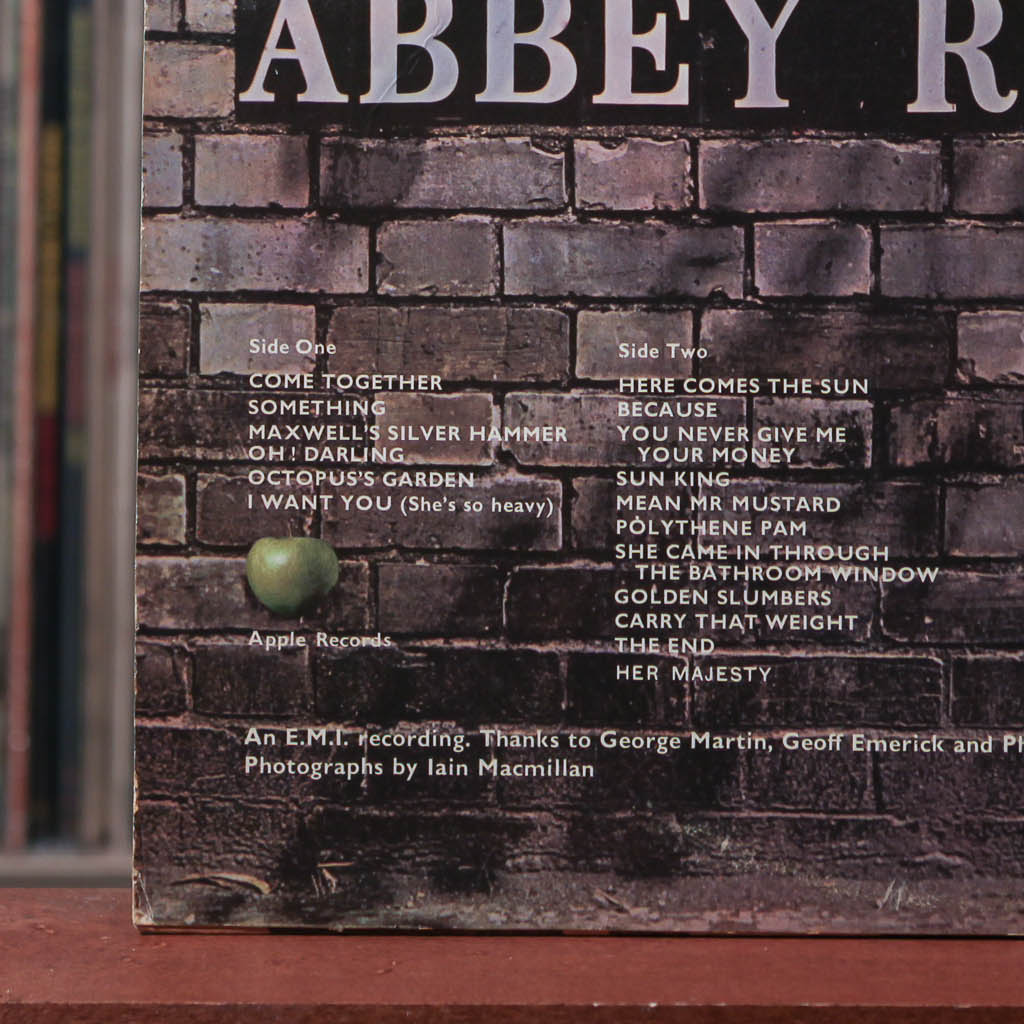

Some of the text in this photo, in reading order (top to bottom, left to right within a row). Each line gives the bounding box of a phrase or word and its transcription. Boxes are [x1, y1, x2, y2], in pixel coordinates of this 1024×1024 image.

[249, 339, 337, 355] Side One
[618, 343, 708, 359] Side Two
[249, 374, 442, 390] COME TOGETHER
[619, 378, 868, 394] HERE COMES THE SUN
[248, 399, 386, 416] SOMETHING
[618, 402, 718, 418] BECAUSE
[388, 426, 461, 442] SILVER
[470, 427, 568, 442] HAMMER
[616, 426, 847, 443] YOU NEVER GIVE ME
[305, 446, 404, 463] DARLING
[638, 446, 796, 463] YOUR MONEY
[382, 472, 475, 488] GARDEN
[616, 471, 730, 487] SUN KING
[248, 494, 253, 509] I
[261, 494, 333, 510] WANT
[340, 495, 392, 511] YOU
[463, 499, 482, 513] so
[491, 497, 554, 518] heavy)
[616, 495, 841, 513] MEAN MR MUSTARD
[616, 519, 807, 536] POLYTHENE PAM
[615, 544, 889, 562] SHE CAME IN THROUGH
[635, 565, 939, 583] THE BATHROOM WINDOW
[614, 589, 832, 606] GOLDEN SLUMBERS
[614, 614, 858, 631] CARRY THAT WEIGHT
[249, 631, 392, 651] Apple Records
[614, 638, 715, 654] THE END
[616, 665, 772, 682] HER MAJESTY
[244, 727, 276, 746] An
[286, 728, 348, 746] E.M.I.
[358, 730, 470, 752] recording.
[480, 730, 559, 748] Thanks
[569, 733, 591, 748] to
[600, 730, 681, 754] George
[690, 732, 773, 752] Martin,
[782, 732, 844, 752] Geoff
[852, 733, 945, 753] Emerick
[954, 736, 993, 753] and
[245, 756, 594, 780] Photographs by Iain Macmillan
